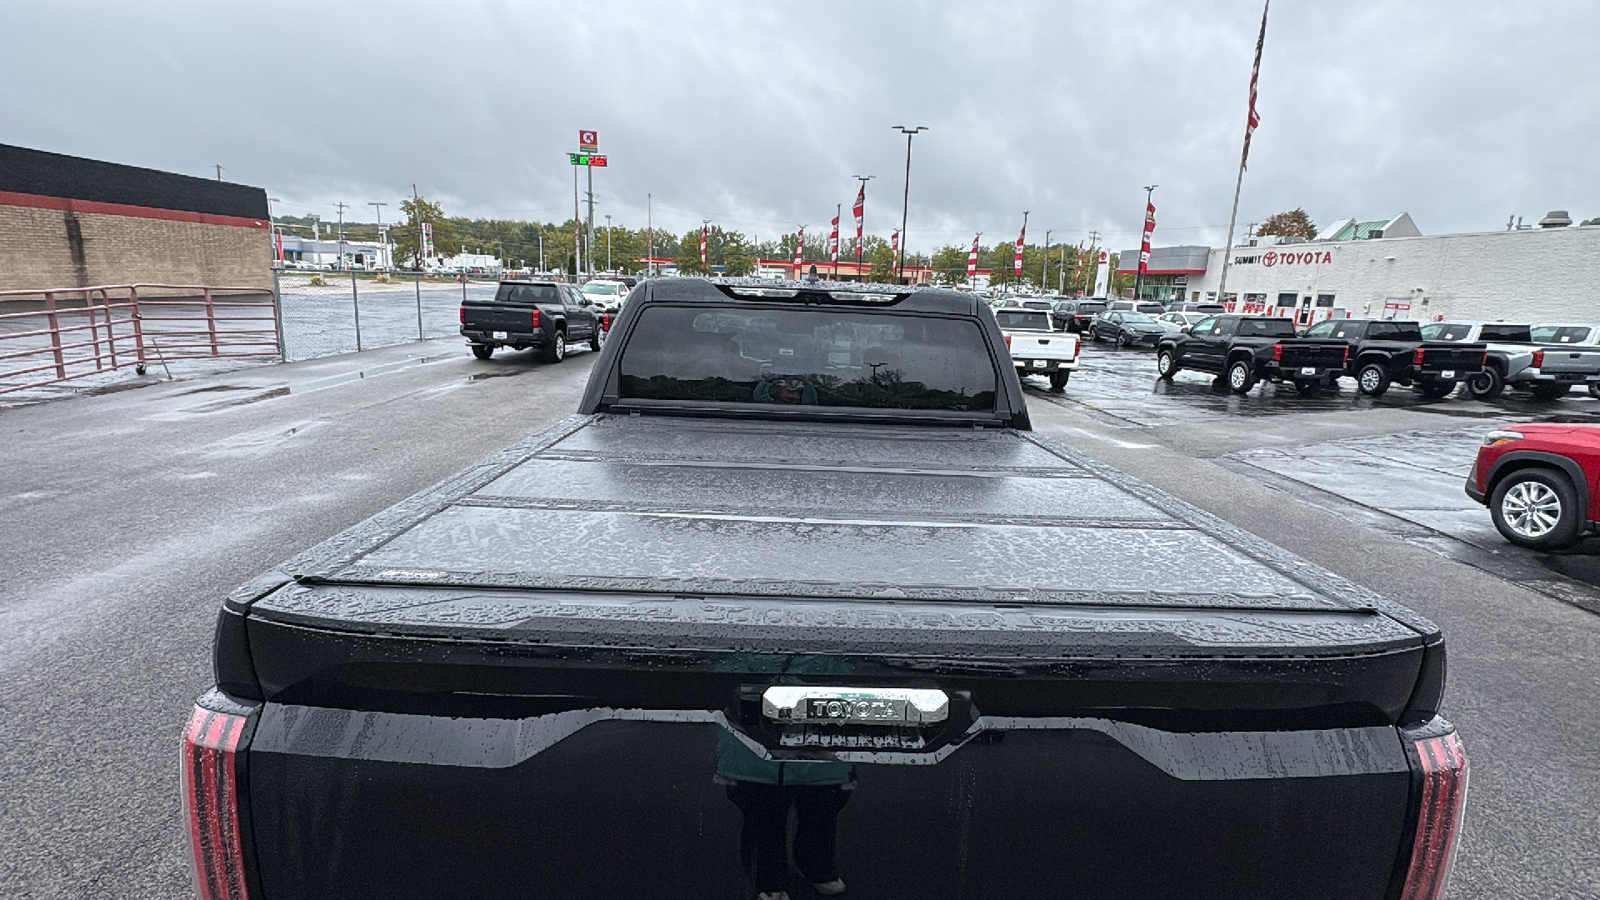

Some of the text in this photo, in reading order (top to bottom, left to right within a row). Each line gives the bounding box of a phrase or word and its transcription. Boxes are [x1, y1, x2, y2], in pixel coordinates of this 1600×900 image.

[1234, 251, 1332, 265] SUMMIT TOYOTA
[812, 700, 899, 718] TOYOTA
